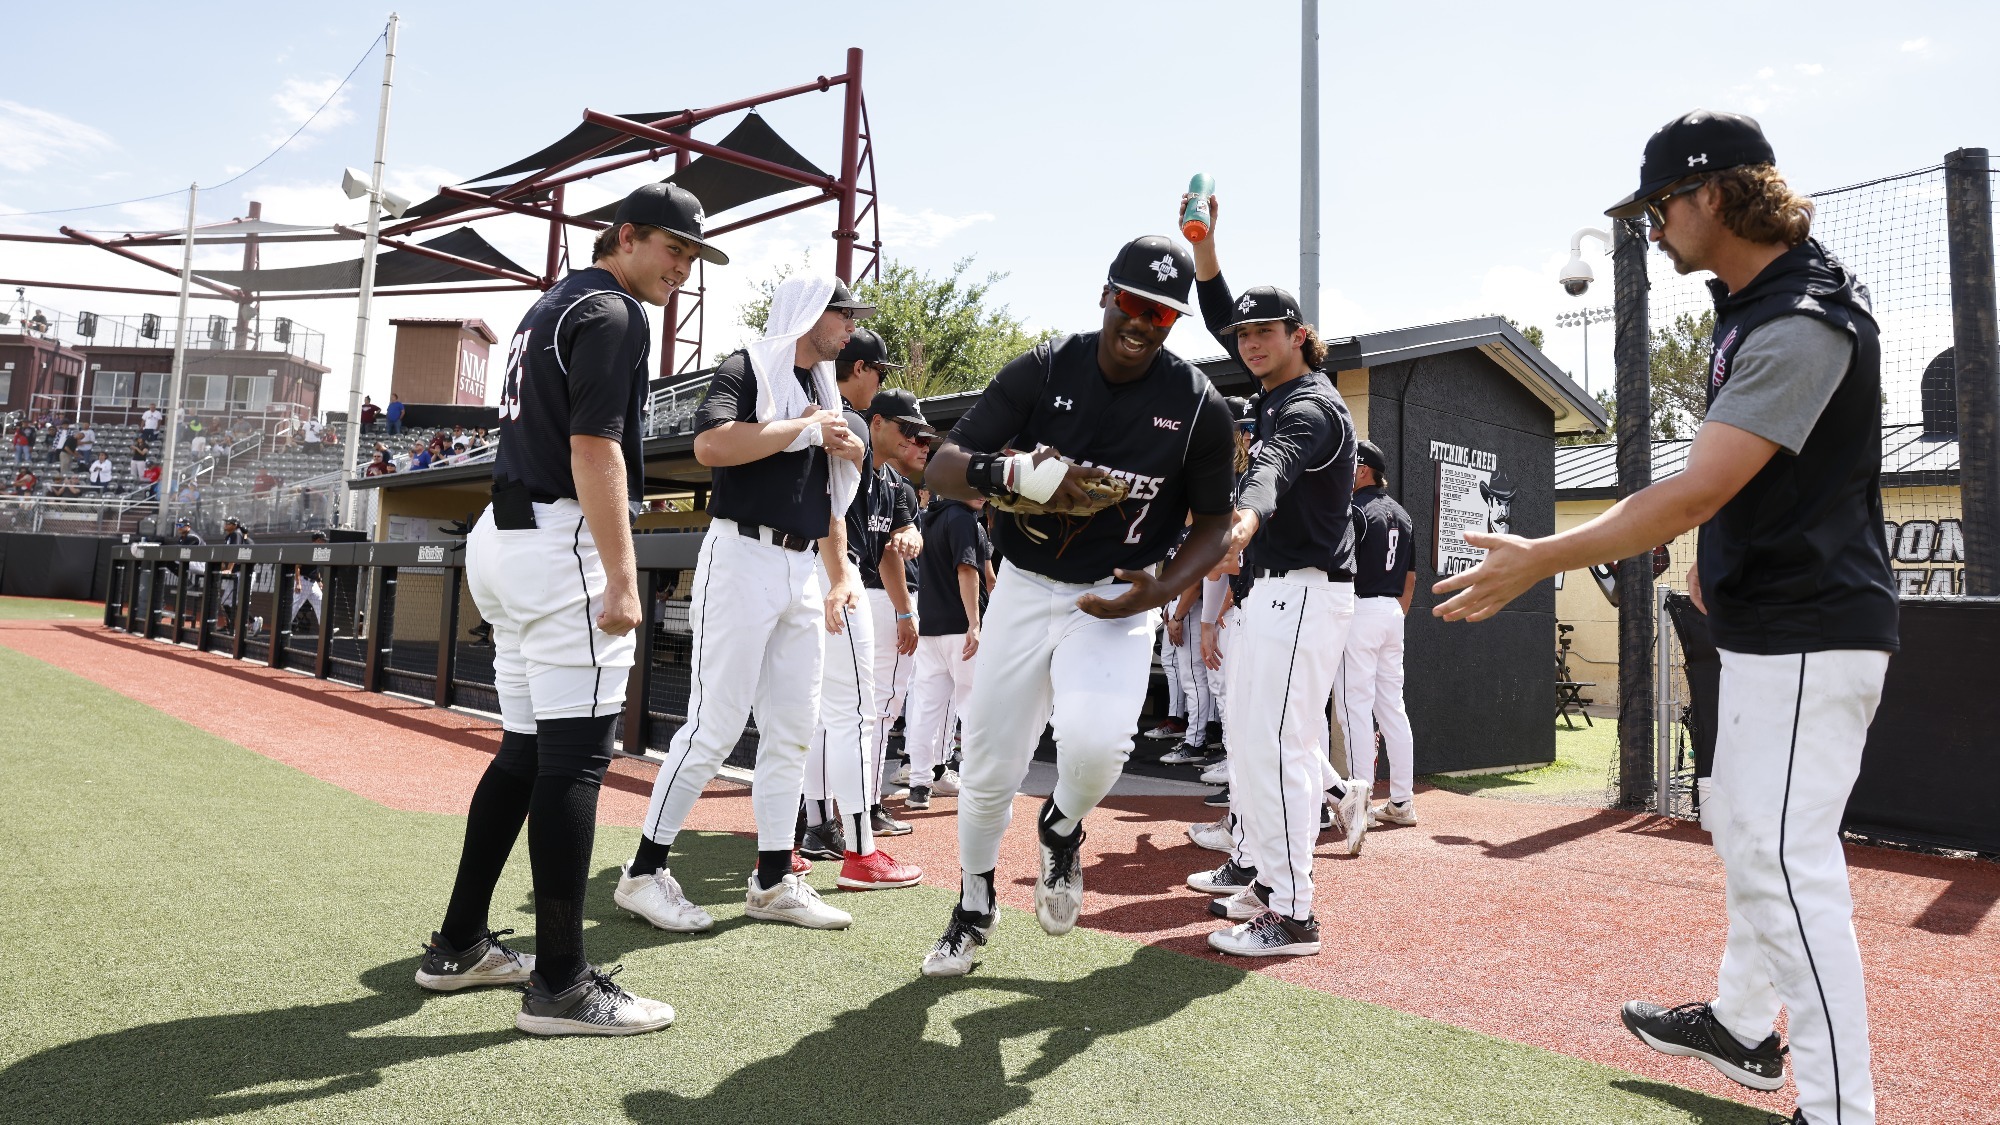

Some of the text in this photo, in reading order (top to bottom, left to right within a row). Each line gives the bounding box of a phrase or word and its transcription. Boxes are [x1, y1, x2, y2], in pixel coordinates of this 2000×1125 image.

[461, 350, 486, 384] NM
[460, 376, 484, 398] STATE
[1153, 417, 1181, 431] WAC
[1429, 440, 1497, 472] PITCHING CREED
[1385, 528, 1400, 572] 8
